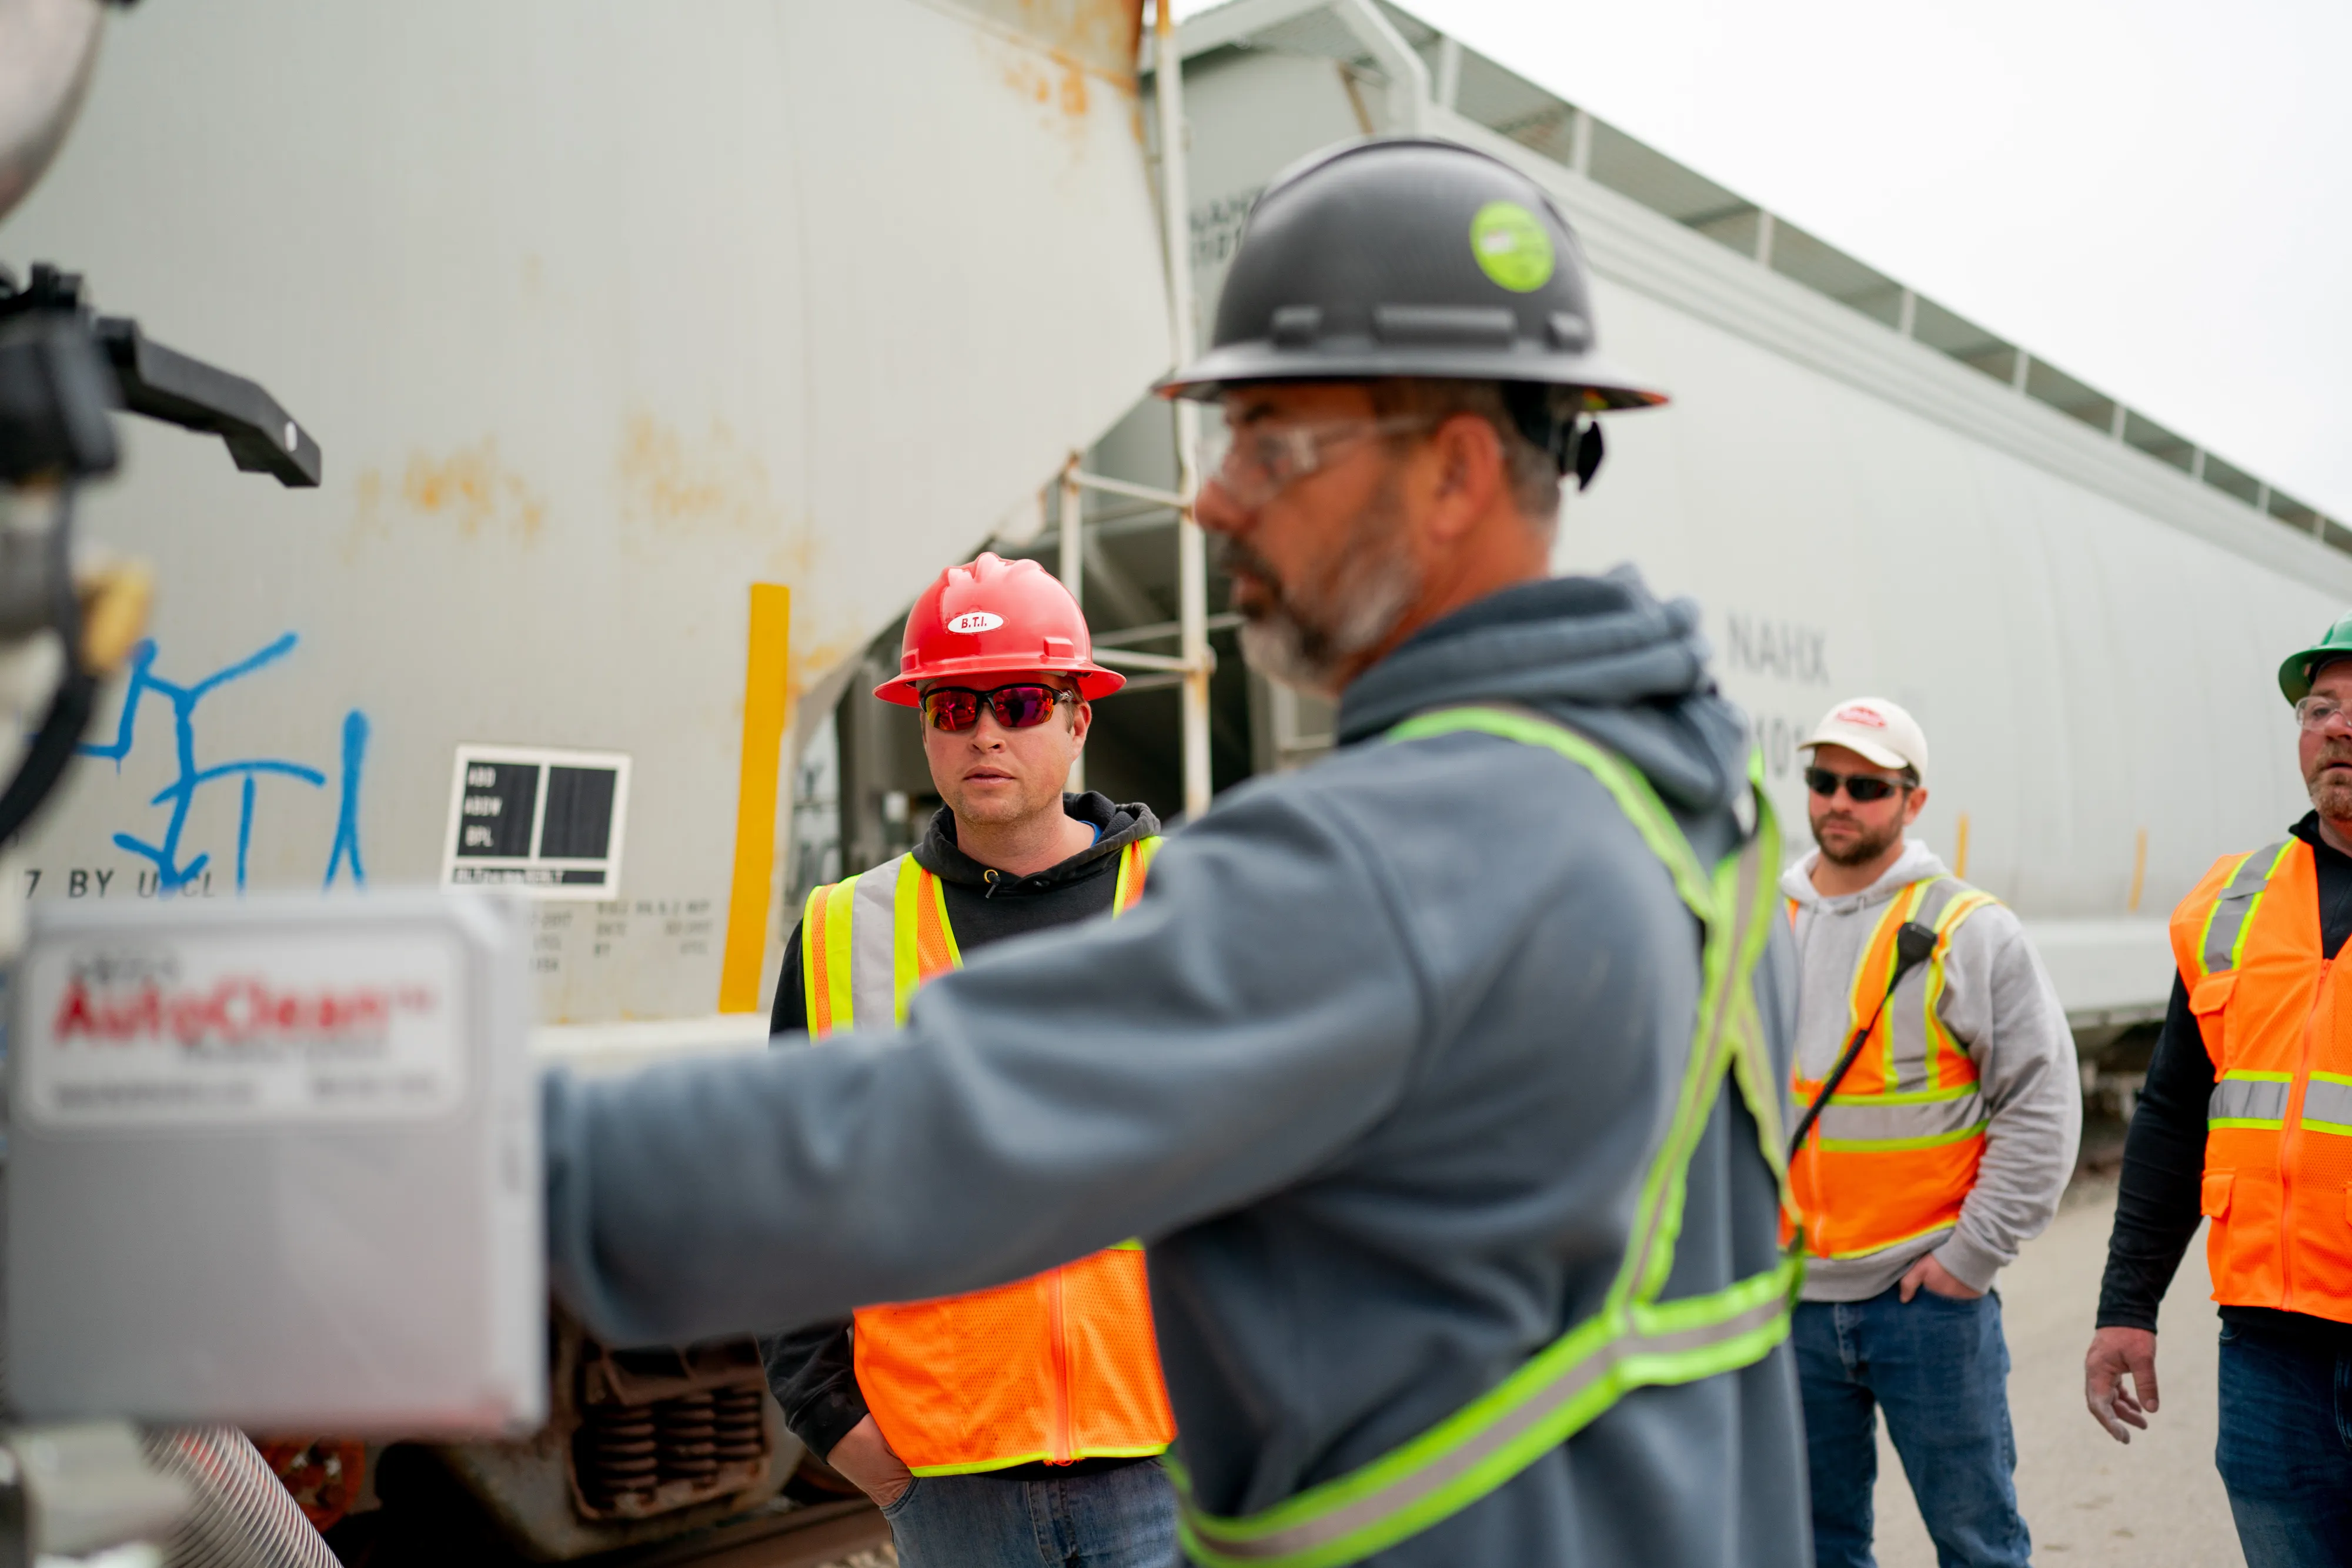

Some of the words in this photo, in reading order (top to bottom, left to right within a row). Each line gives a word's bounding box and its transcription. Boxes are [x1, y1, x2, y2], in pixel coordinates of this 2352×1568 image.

[961, 616, 987, 629] B.T.I.
[68, 870, 115, 898] BY
[138, 870, 215, 898] UCL
